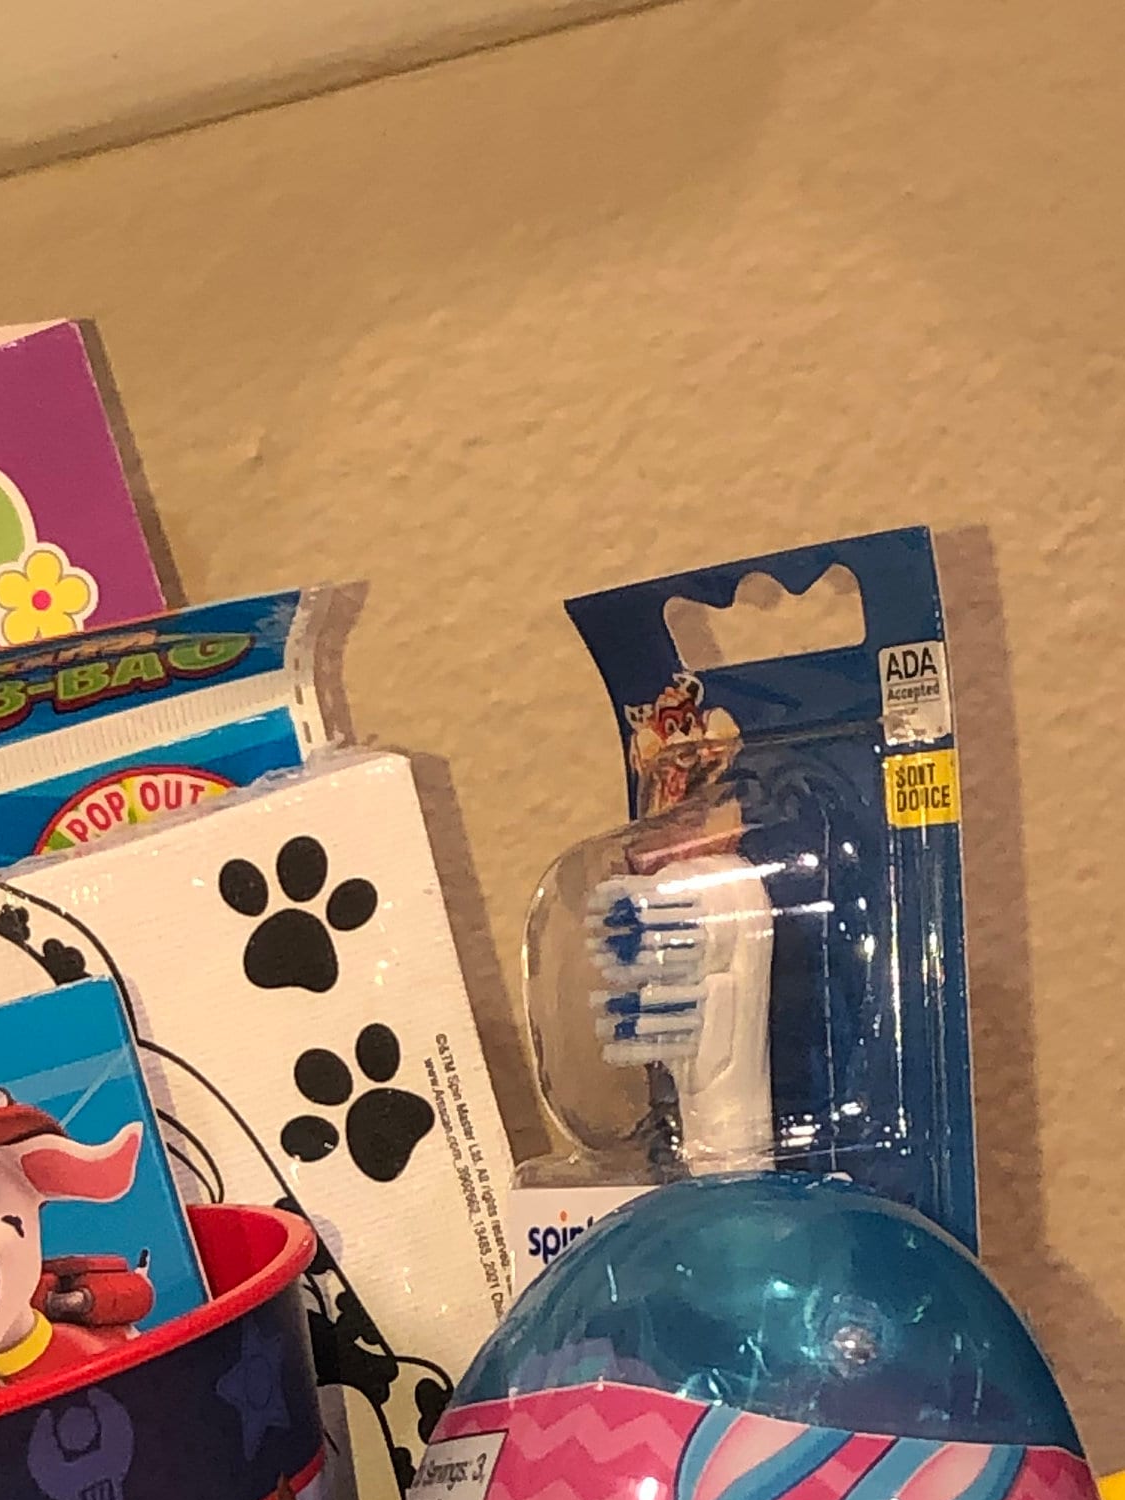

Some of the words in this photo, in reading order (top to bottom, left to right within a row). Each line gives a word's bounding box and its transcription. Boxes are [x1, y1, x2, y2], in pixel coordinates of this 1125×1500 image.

[886, 646, 938, 682] ADA
[887, 683, 941, 701] Accepted
[66, 791, 125, 843] POP
[140, 779, 205, 811] OUT
